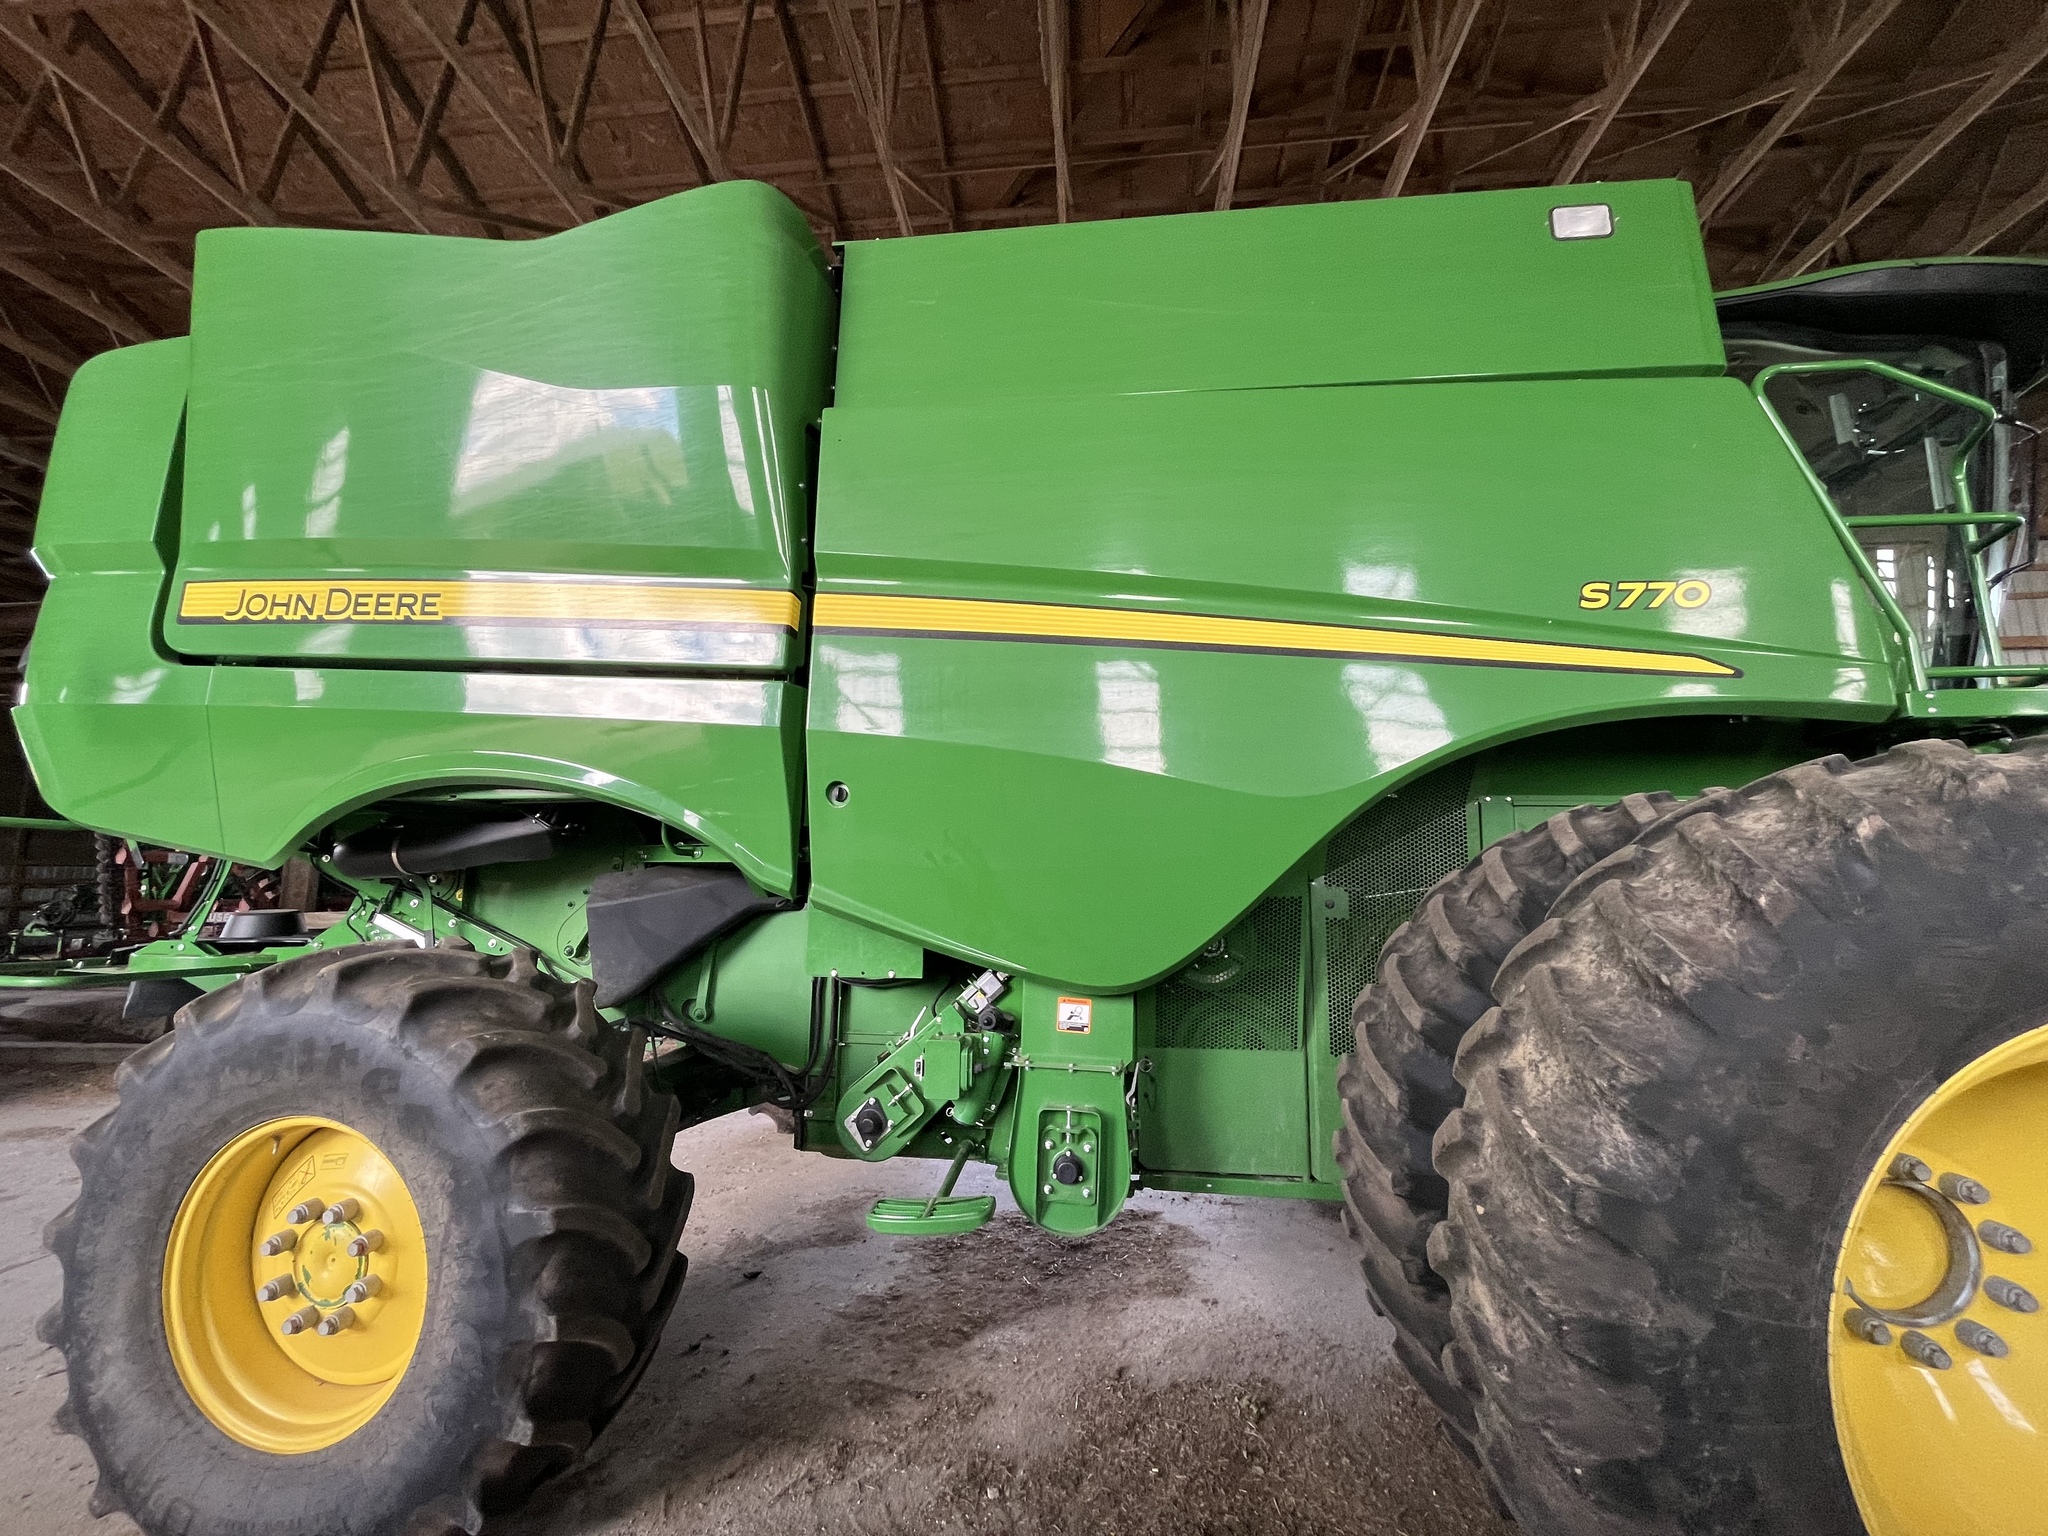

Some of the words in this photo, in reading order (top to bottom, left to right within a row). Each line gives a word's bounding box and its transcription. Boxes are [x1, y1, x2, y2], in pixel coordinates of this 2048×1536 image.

[224, 589, 317, 618] JOHN
[324, 588, 442, 618] DEERE
[1579, 579, 1712, 610] S770
[207, 911, 231, 923] USE
